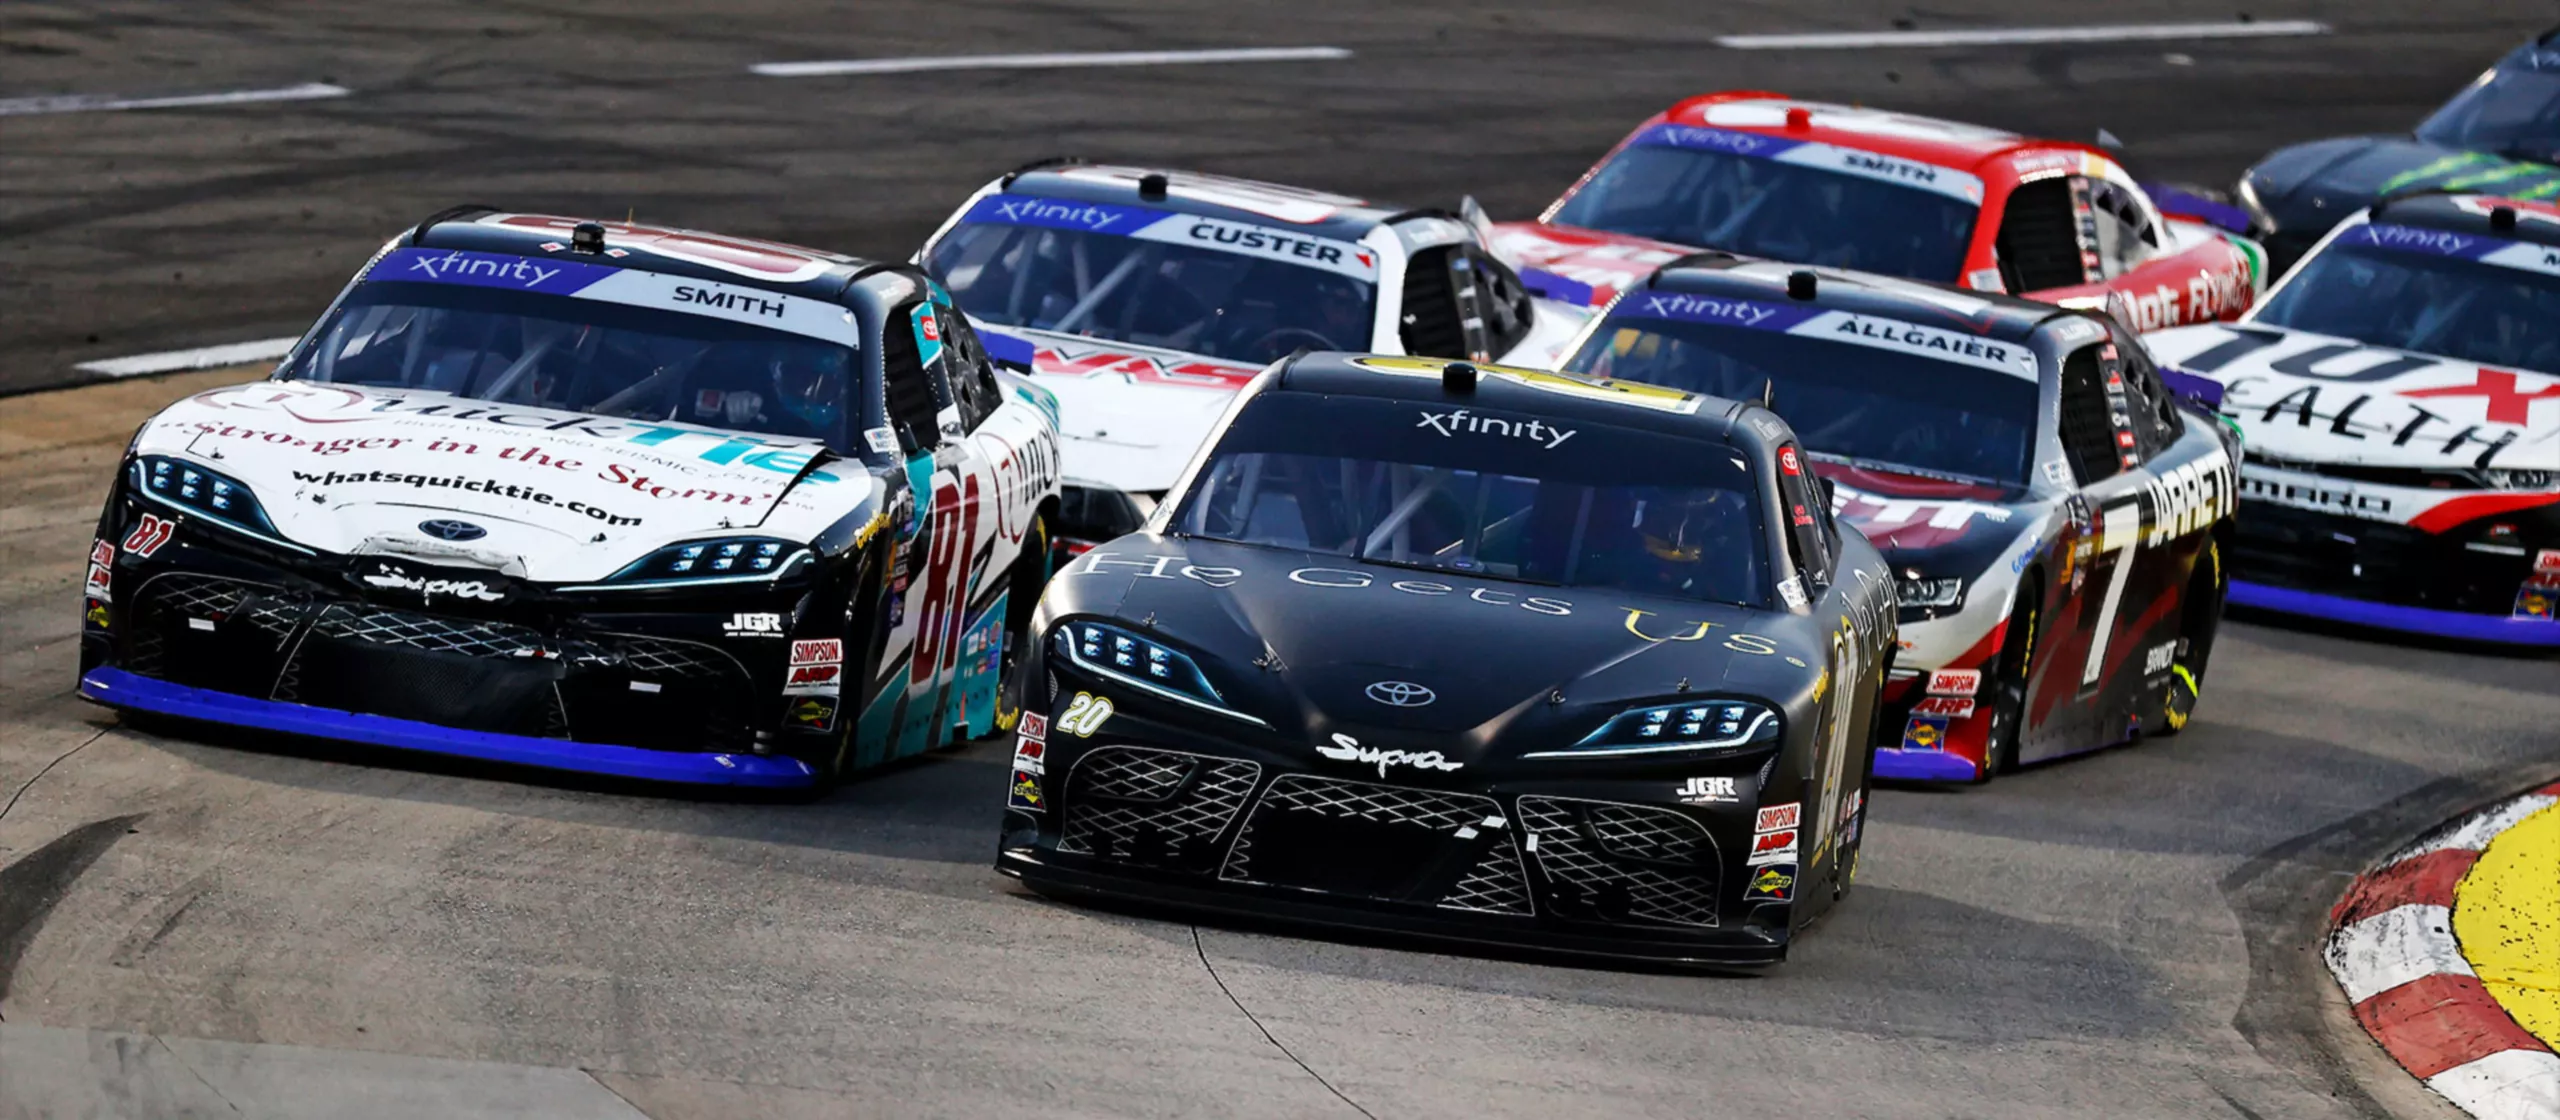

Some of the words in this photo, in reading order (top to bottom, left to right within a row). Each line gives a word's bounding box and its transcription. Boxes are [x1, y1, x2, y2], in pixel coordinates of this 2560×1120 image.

[1842, 154, 1937, 182] SMITH
[995, 199, 1121, 229] xfinity
[1190, 223, 1343, 264] CUSTER
[409, 251, 561, 287] xfinity
[673, 286, 786, 318] SMITH
[1644, 294, 1776, 326] xfinity
[1837, 318, 2007, 363] ALLGAIER
[1416, 409, 1576, 449] xfinity
[427, 437, 482, 454] in
[499, 446, 583, 472] the
[292, 470, 642, 527] whatsquicktie.com
[123, 512, 175, 558] 81
[910, 472, 980, 685] 81
[2083, 502, 2140, 685] 7
[722, 612, 783, 631] JGR
[1074, 552, 1243, 588] He
[1288, 567, 1574, 617] Gets
[1618, 606, 1808, 668] Us.
[793, 640, 838, 663] SIMPSON
[790, 665, 840, 683] ARP
[1056, 691, 1115, 738] 20
[1914, 698, 1974, 713] ARP
[1315, 732, 1464, 779] Supra
[1676, 777, 1737, 796] JGR
[1758, 806, 1798, 830] SIMPSON
[1757, 832, 1795, 852] ARP
